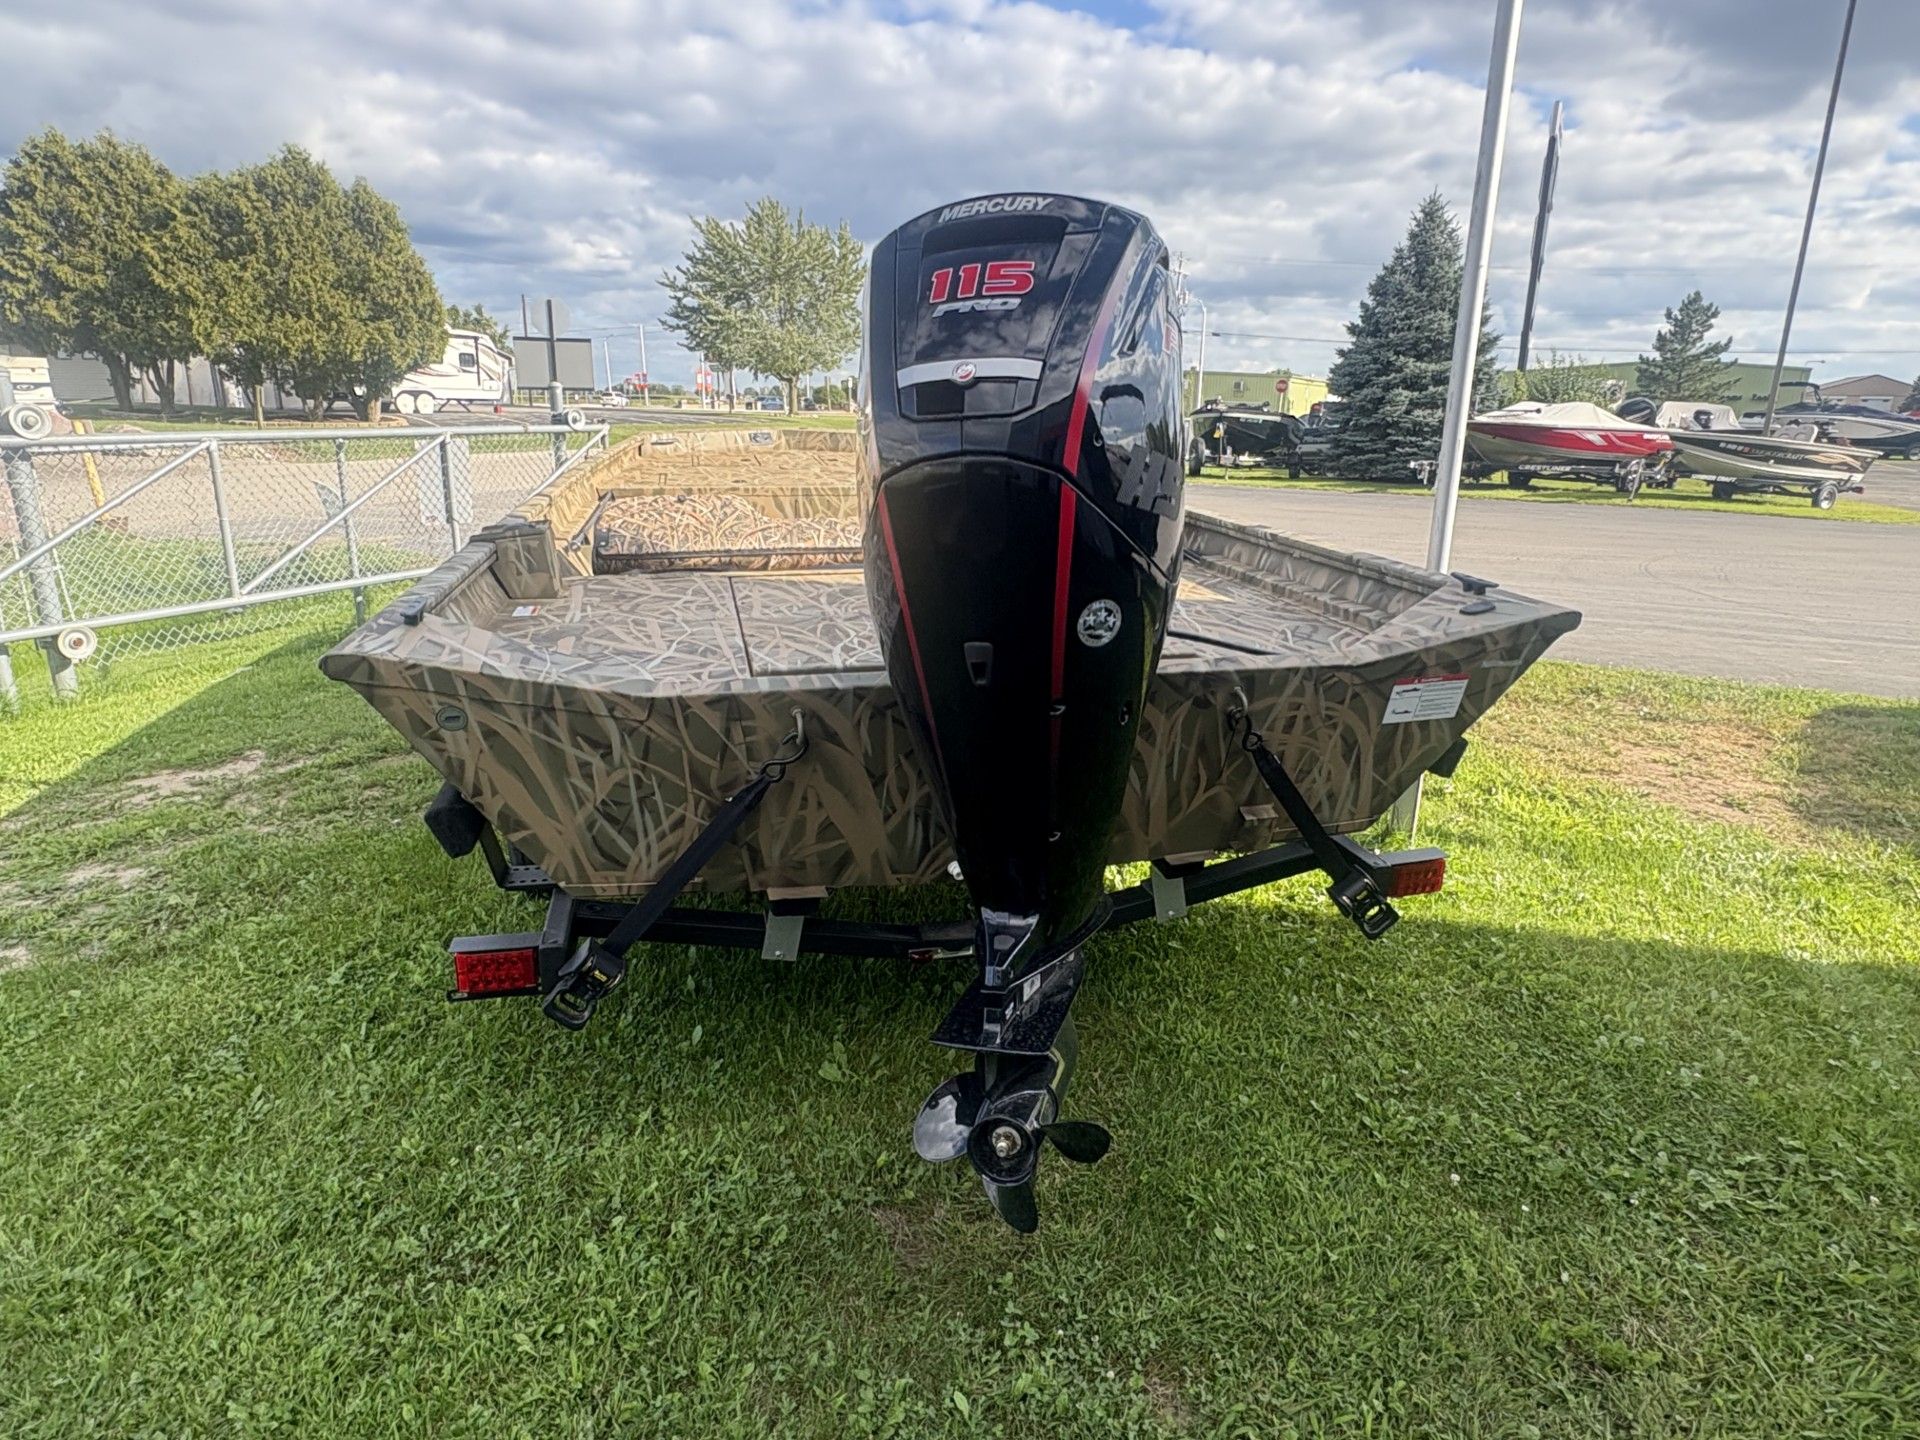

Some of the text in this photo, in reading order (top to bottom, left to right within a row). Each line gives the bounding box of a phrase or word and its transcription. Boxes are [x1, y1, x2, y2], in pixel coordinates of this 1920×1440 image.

[938, 196, 1057, 224] MERCURY
[929, 261, 1035, 304] 115
[932, 297, 1022, 318] PRO
